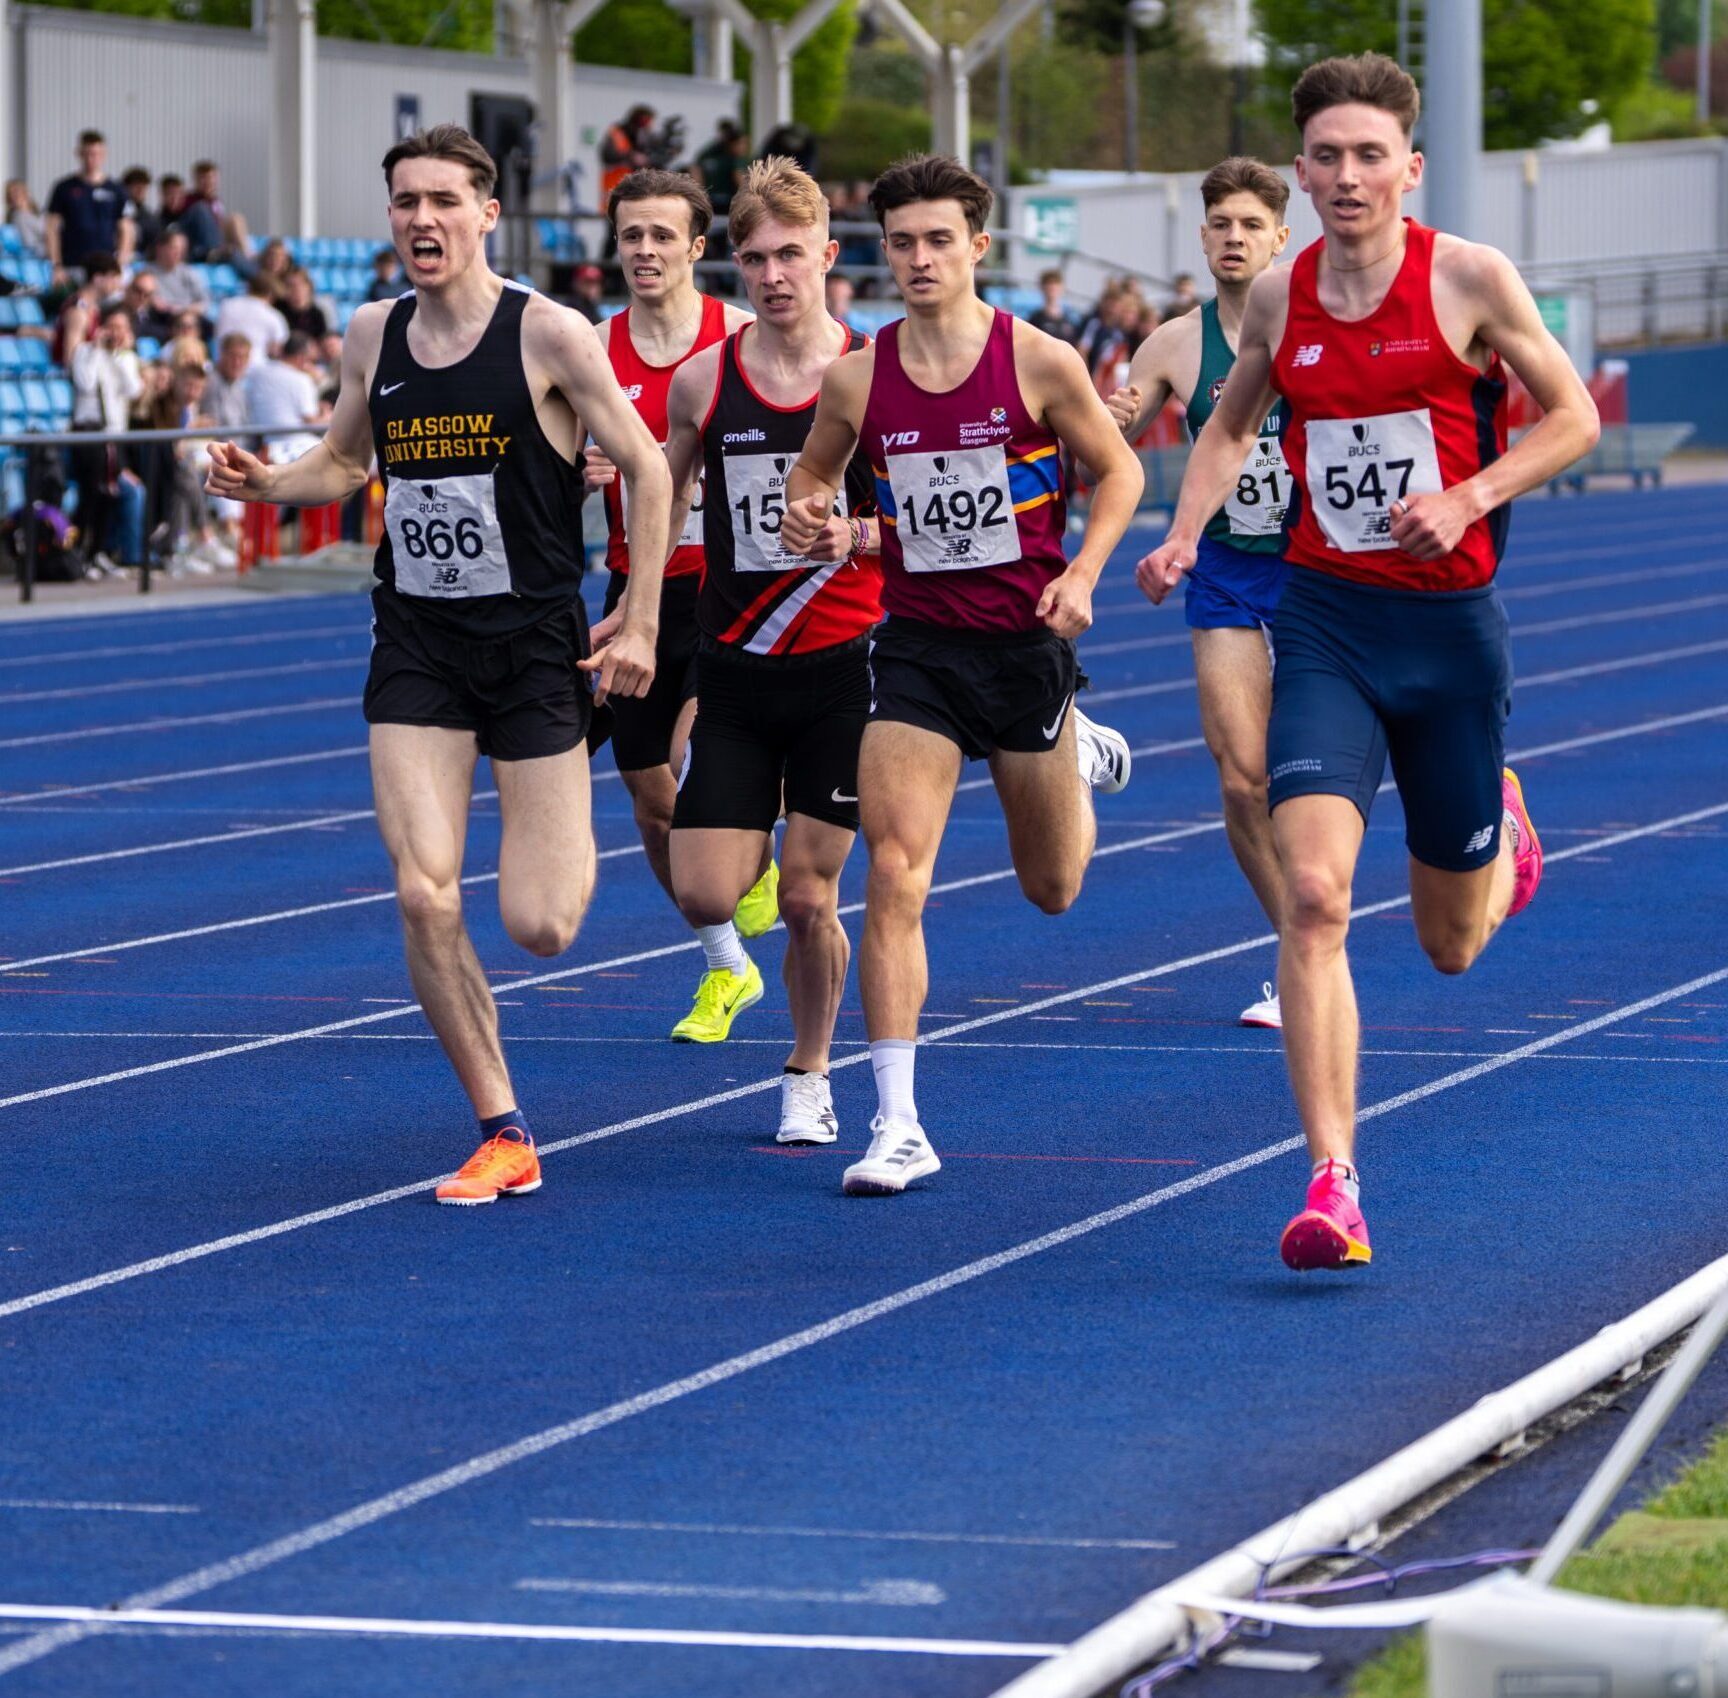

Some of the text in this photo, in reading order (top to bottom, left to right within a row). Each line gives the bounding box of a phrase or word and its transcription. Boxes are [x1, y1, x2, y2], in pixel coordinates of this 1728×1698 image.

[387, 414, 494, 440] GLASGOW
[959, 421, 982, 429] University
[959, 425, 1011, 437] Strathclyde
[881, 431, 920, 447] V10
[959, 437, 989, 446] Glasgow
[384, 436, 511, 463] UNIVERSITY
[1348, 443, 1381, 457] BUCS
[1255, 456, 1281, 468] BUCS
[929, 475, 960, 488] BUCS
[1325, 458, 1415, 511] 547
[419, 502, 448, 513] BUCS
[902, 485, 1008, 536] 1492
[400, 517, 484, 560] 866
[1464, 824, 1495, 854] NB
